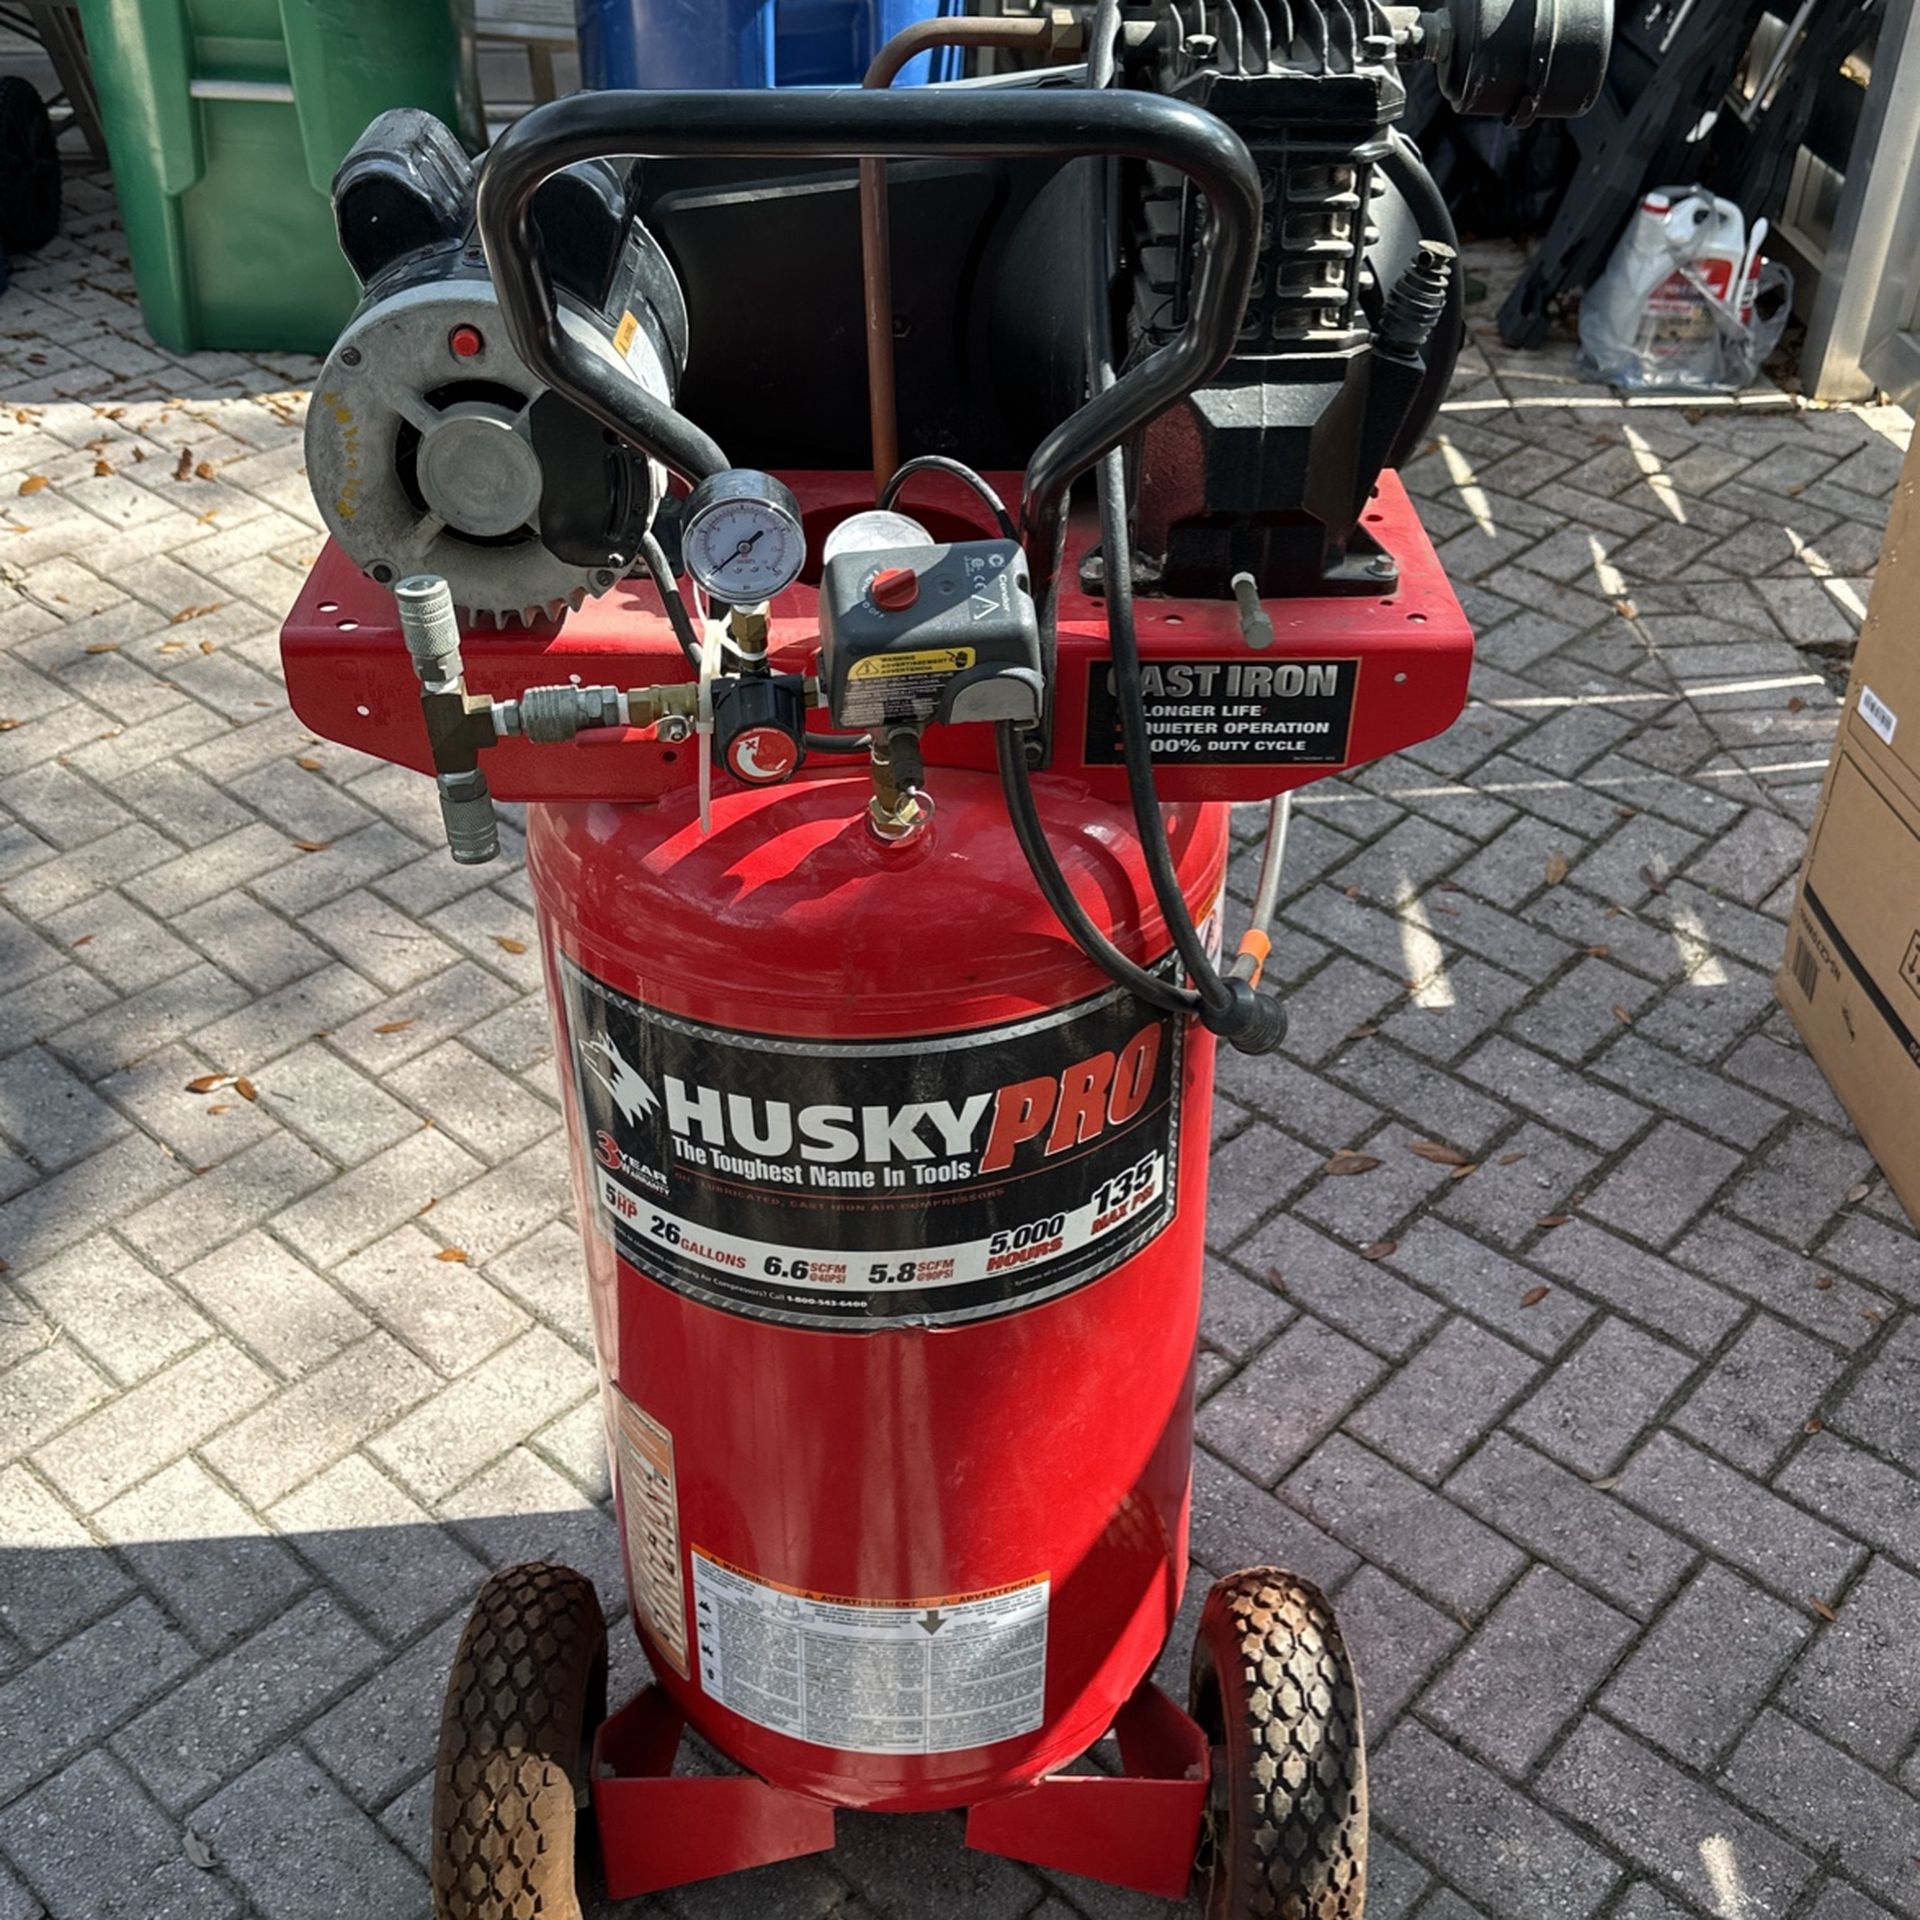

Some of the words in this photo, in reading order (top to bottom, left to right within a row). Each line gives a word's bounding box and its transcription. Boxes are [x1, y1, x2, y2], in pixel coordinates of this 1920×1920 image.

[1226, 664, 1338, 697] IRON
[1222, 705, 1262, 717] LIFE
[1224, 722, 1330, 734] OPERATION
[1150, 739, 1201, 752] 00%
[1207, 741, 1250, 751] DUTY
[1254, 741, 1307, 751] CYCLE
[663, 1074, 993, 1163] HUSKY
[978, 1022, 1162, 1173] PRO
[594, 1130, 623, 1169] 3
[618, 1149, 668, 1185] YEAR
[672, 1134, 706, 1165] The
[709, 1147, 803, 1185] Toughest
[810, 1165, 876, 1188] Name
[884, 1166, 906, 1187] In
[606, 1182, 618, 1206] 5
[617, 1194, 638, 1219] HP
[1093, 1151, 1156, 1216] 135
[988, 1213, 1066, 1254] 5,000
[1091, 1200, 1130, 1236] MAX
[650, 1214, 681, 1245] 26
[680, 1238, 747, 1270] GALLONS
[986, 1236, 1063, 1271] HOURS
[764, 1256, 809, 1280] 6.6
[809, 1262, 847, 1274] SCFM
[868, 1262, 917, 1284] 5.8
[916, 1258, 955, 1272] SCFM
